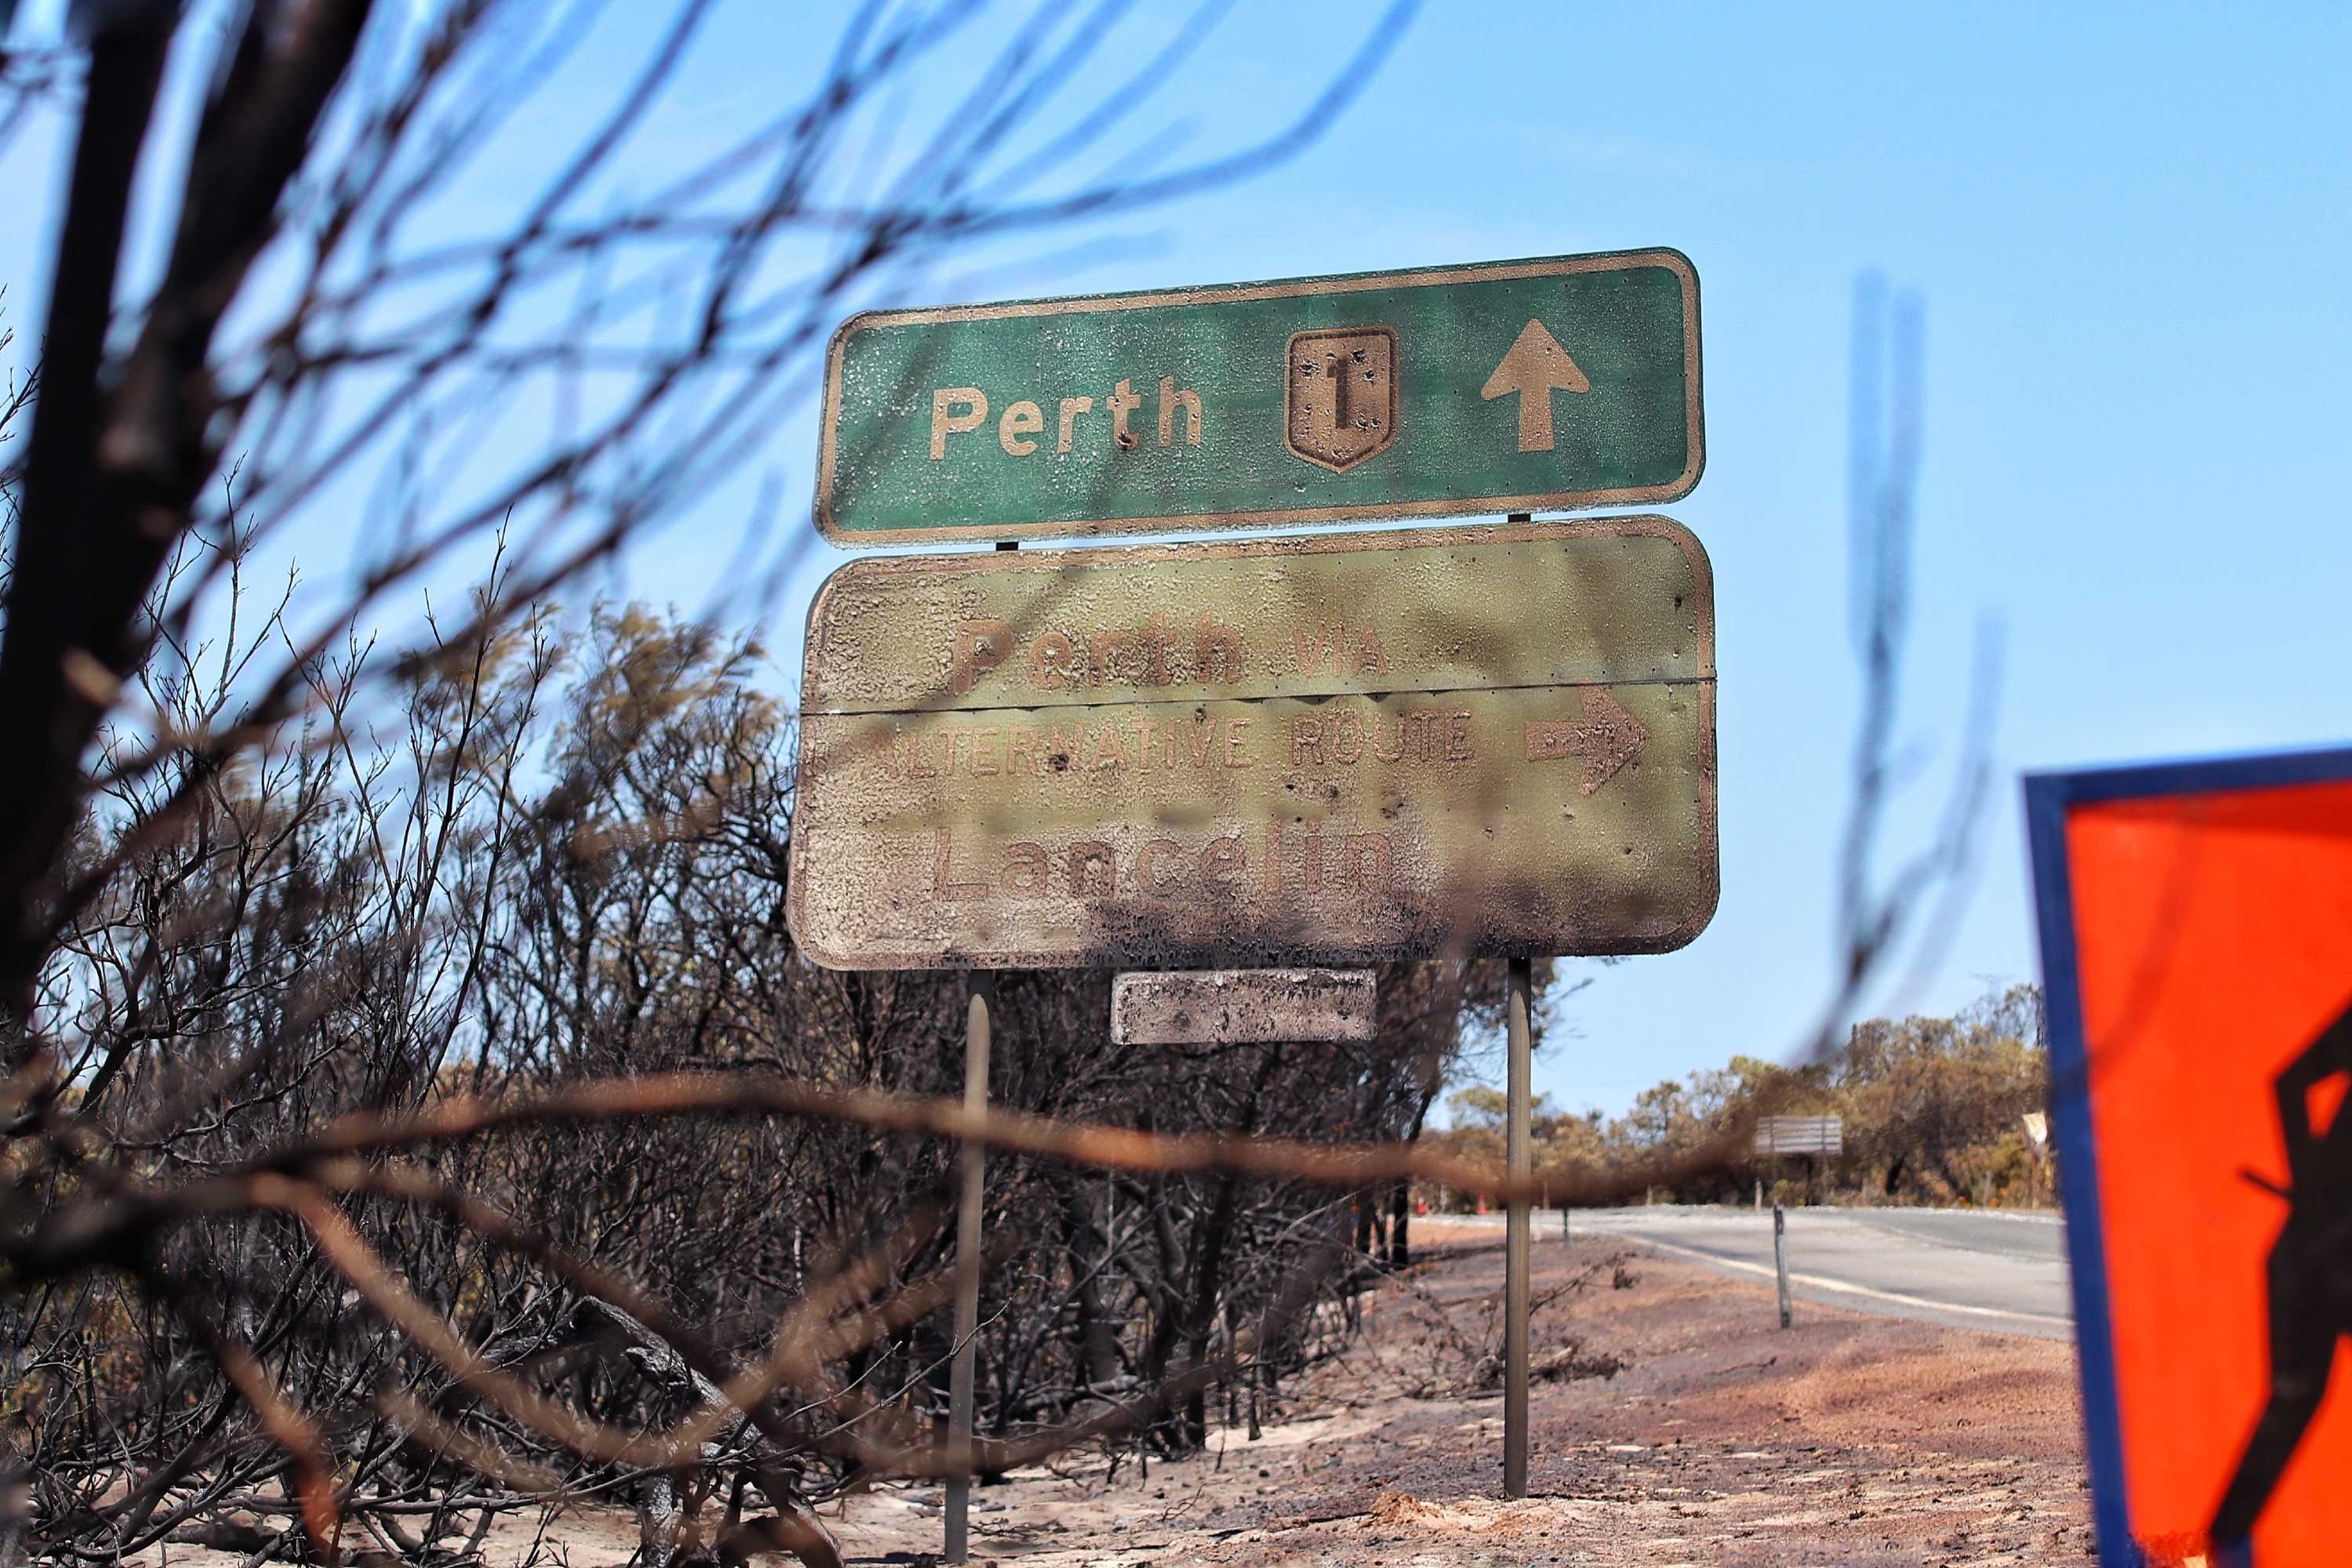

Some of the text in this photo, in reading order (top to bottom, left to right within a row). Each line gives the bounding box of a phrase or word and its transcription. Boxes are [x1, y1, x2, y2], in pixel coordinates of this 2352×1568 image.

[930, 356, 1352, 460] Perth 1
[952, 610, 1387, 694] Perth VIA
[1292, 708, 1474, 767] ROUTE
[935, 817, 1394, 902] Lancelin
